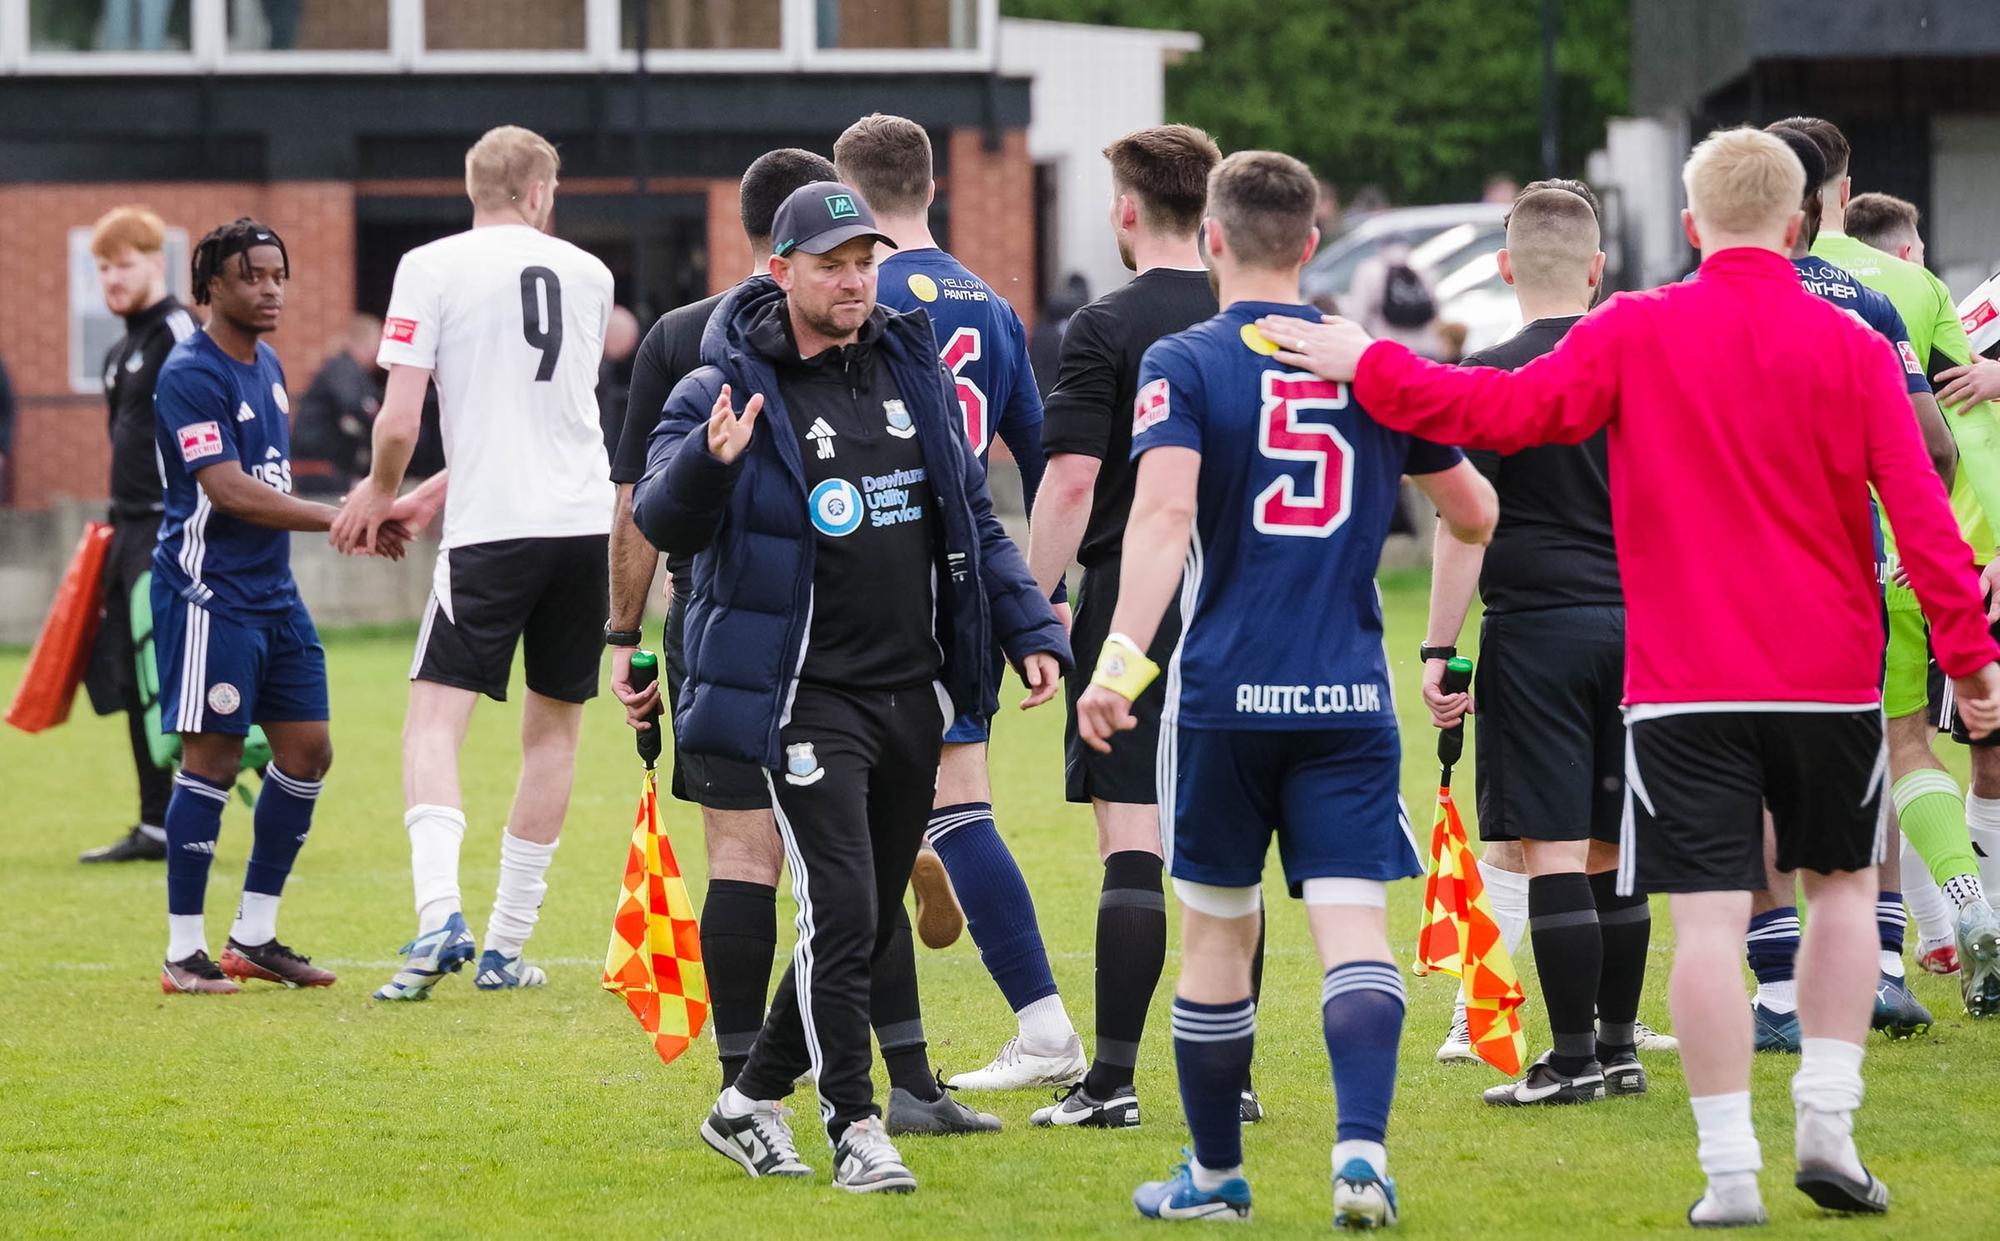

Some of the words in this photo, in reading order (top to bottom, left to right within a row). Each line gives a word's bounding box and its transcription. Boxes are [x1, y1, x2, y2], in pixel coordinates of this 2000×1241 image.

[938, 278, 984, 290] YELLOW
[943, 288, 989, 302] PANTHER
[1801, 280, 1858, 299] NTHER
[520, 265, 563, 382] 9
[1253, 369, 1355, 539] 5
[861, 466, 925, 493] Dewhurs
[865, 488, 909, 511] Utility
[870, 505, 922, 528] Service
[1235, 683, 1381, 714] AUITC.CO.UK
